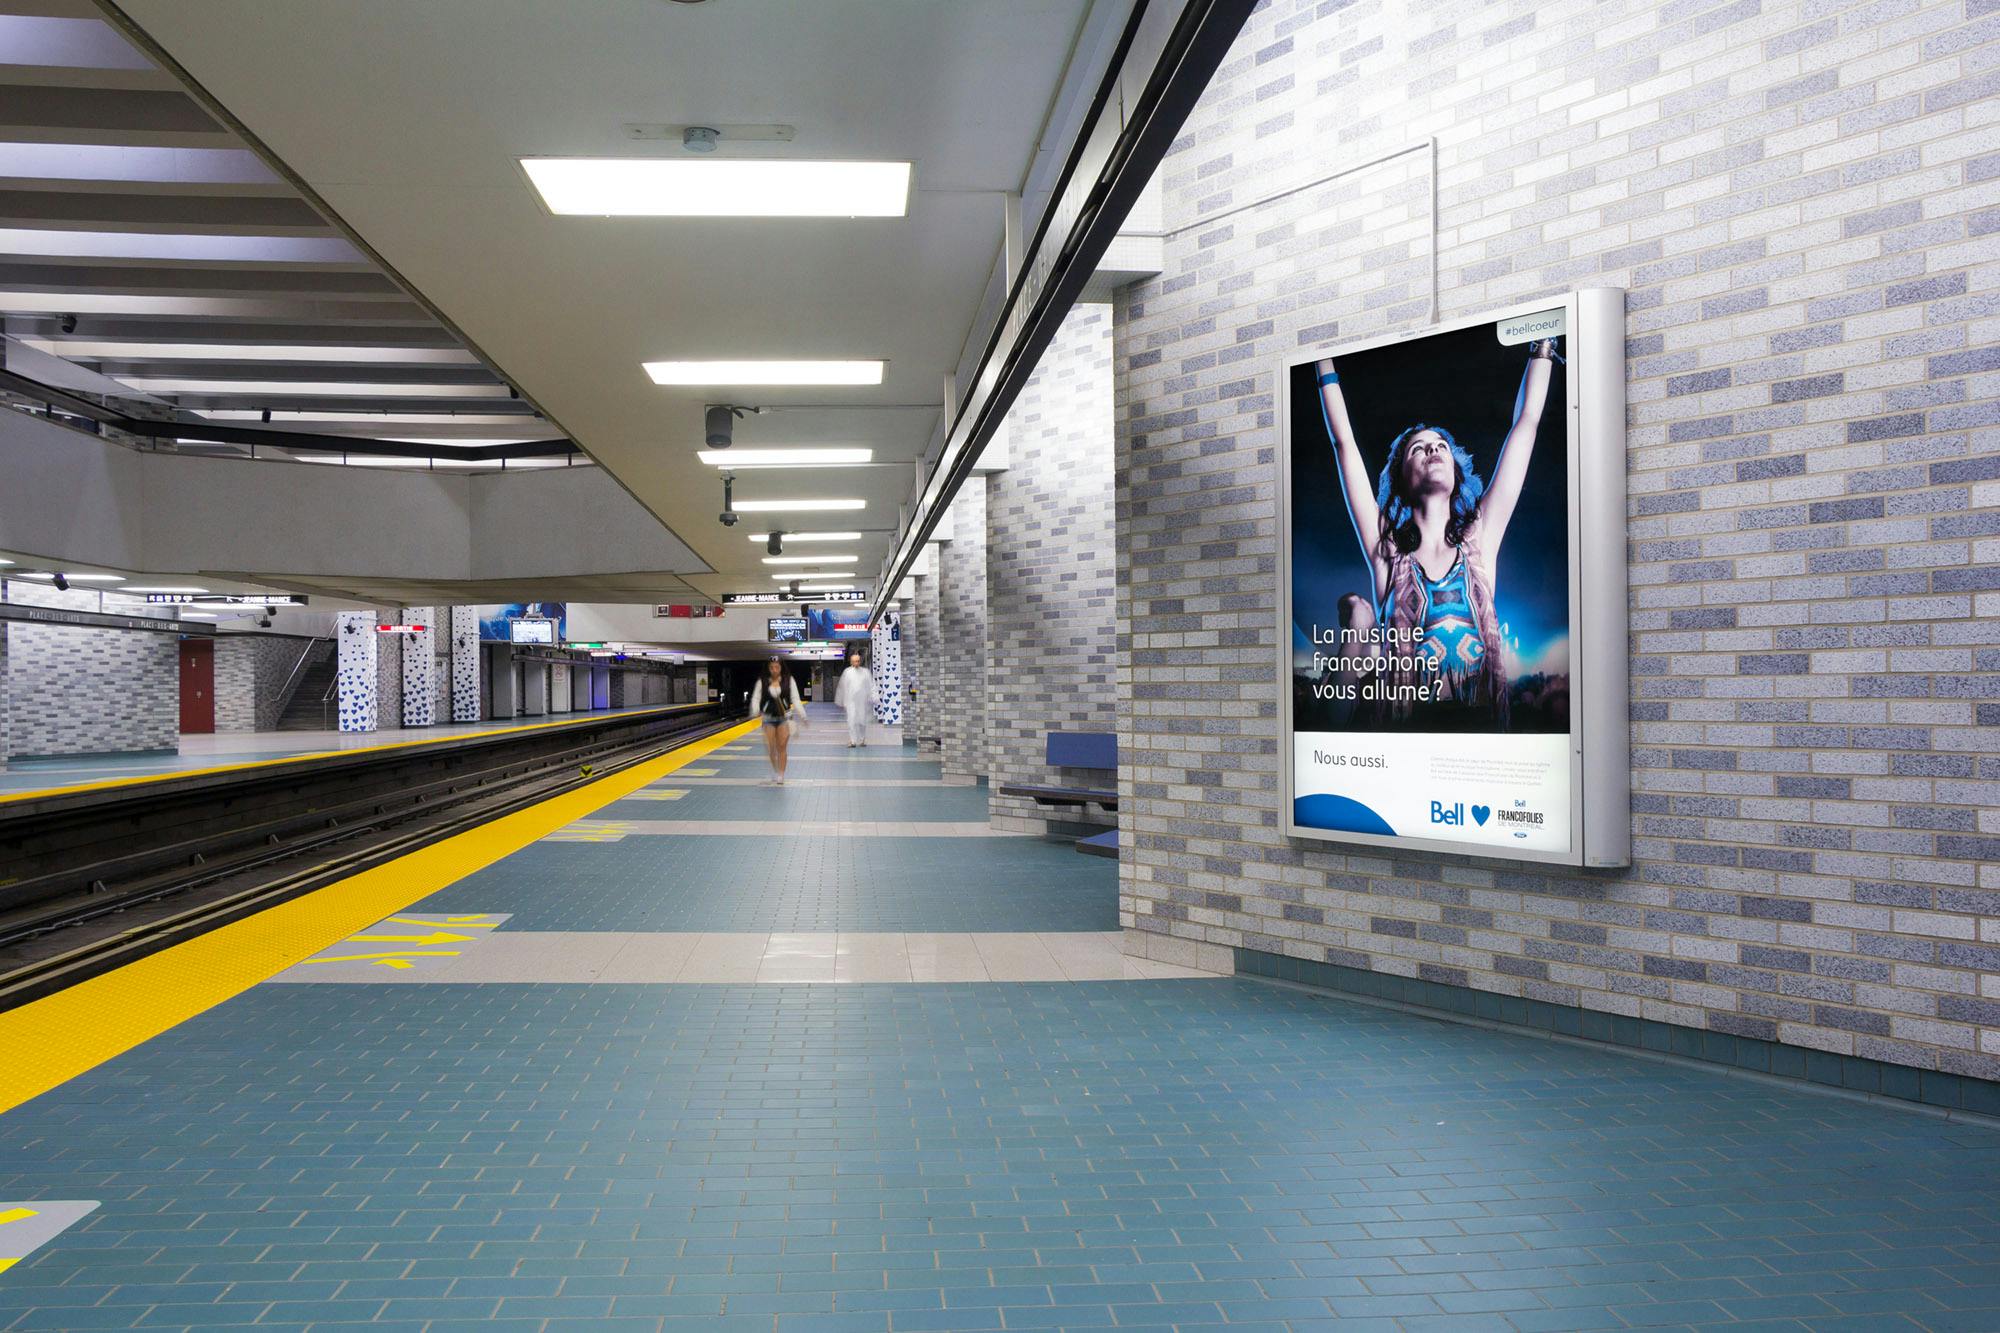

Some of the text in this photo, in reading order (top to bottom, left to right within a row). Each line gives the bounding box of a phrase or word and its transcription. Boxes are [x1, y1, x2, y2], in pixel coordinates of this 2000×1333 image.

[1505, 319, 1560, 336] #bellcoeur
[1313, 623, 1425, 648] La musique
[1313, 651, 1439, 677] francophone
[1313, 684, 1356, 700] vous
[1314, 750, 1389, 769] Nous aussi.
[1514, 799, 1526, 807] Bell
[1431, 800, 1464, 826] Bell
[1497, 809, 1544, 824] FRANCOFOLIES
